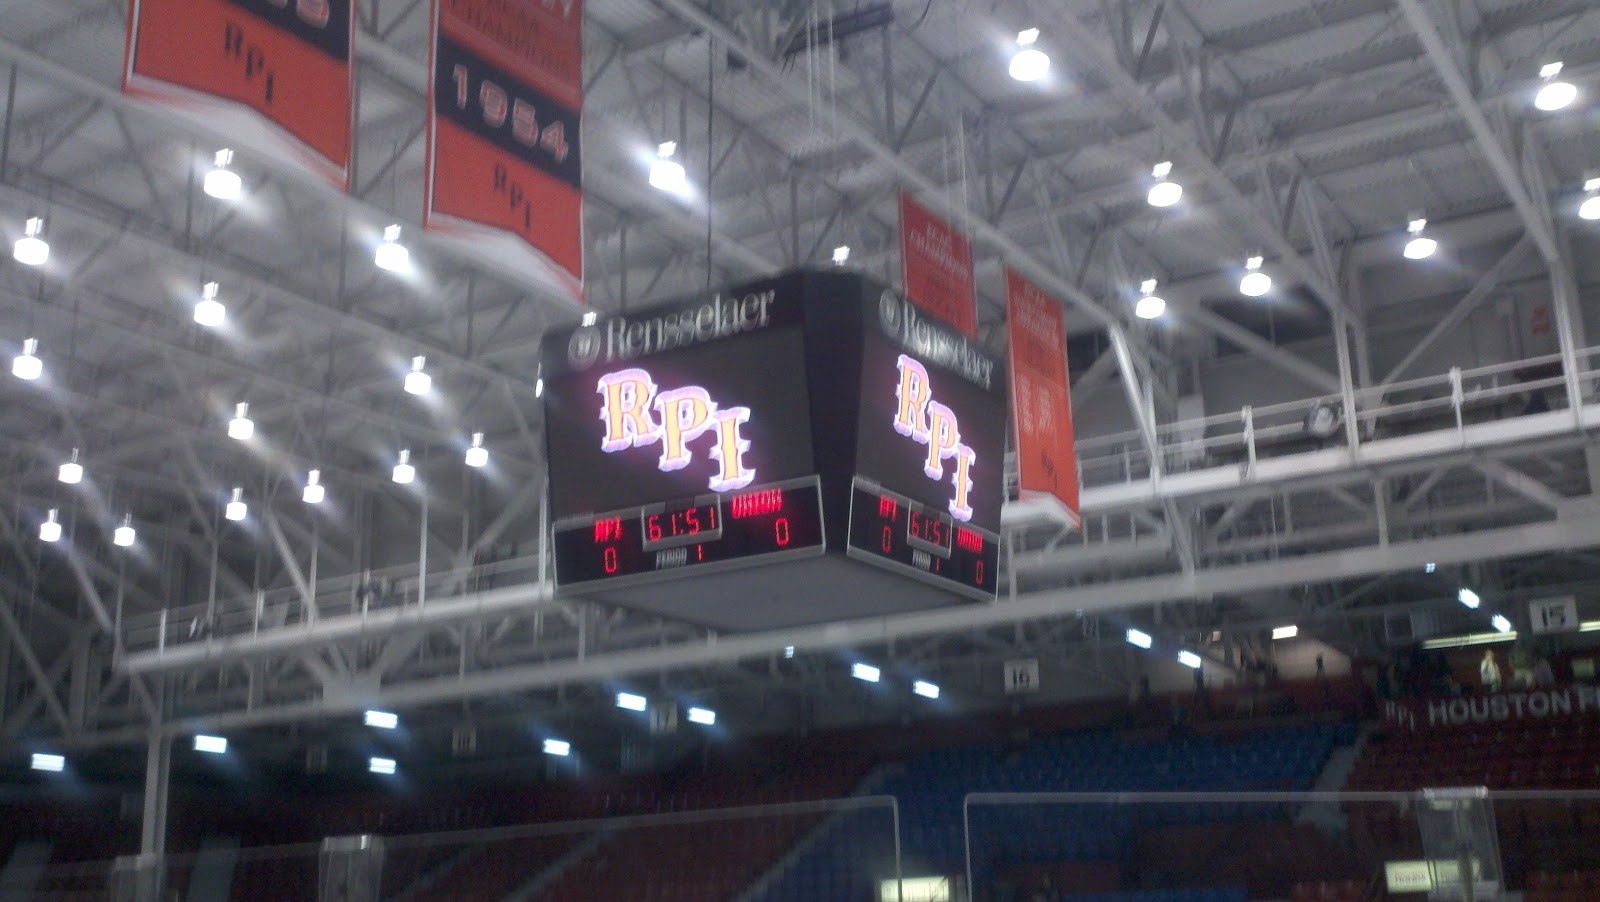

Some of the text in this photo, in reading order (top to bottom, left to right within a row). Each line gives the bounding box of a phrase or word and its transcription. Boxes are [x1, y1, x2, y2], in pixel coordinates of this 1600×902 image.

[224, 18, 275, 105] RPI
[452, 63, 569, 164] 1954
[493, 160, 532, 230] RPI
[606, 290, 775, 362] Rensselaer
[902, 300, 993, 391] Rensselaer
[597, 368, 756, 492] RPI
[893, 354, 976, 522] RPI
[649, 507, 716, 541] 61:51
[775, 518, 789, 545] 0
[882, 526, 892, 553] 0
[912, 512, 950, 548] 61:51
[604, 547, 618, 574] 0
[975, 560, 984, 585] 0
[1541, 604, 1567, 628] 15
[1427, 688, 1571, 727] HOUSTON
